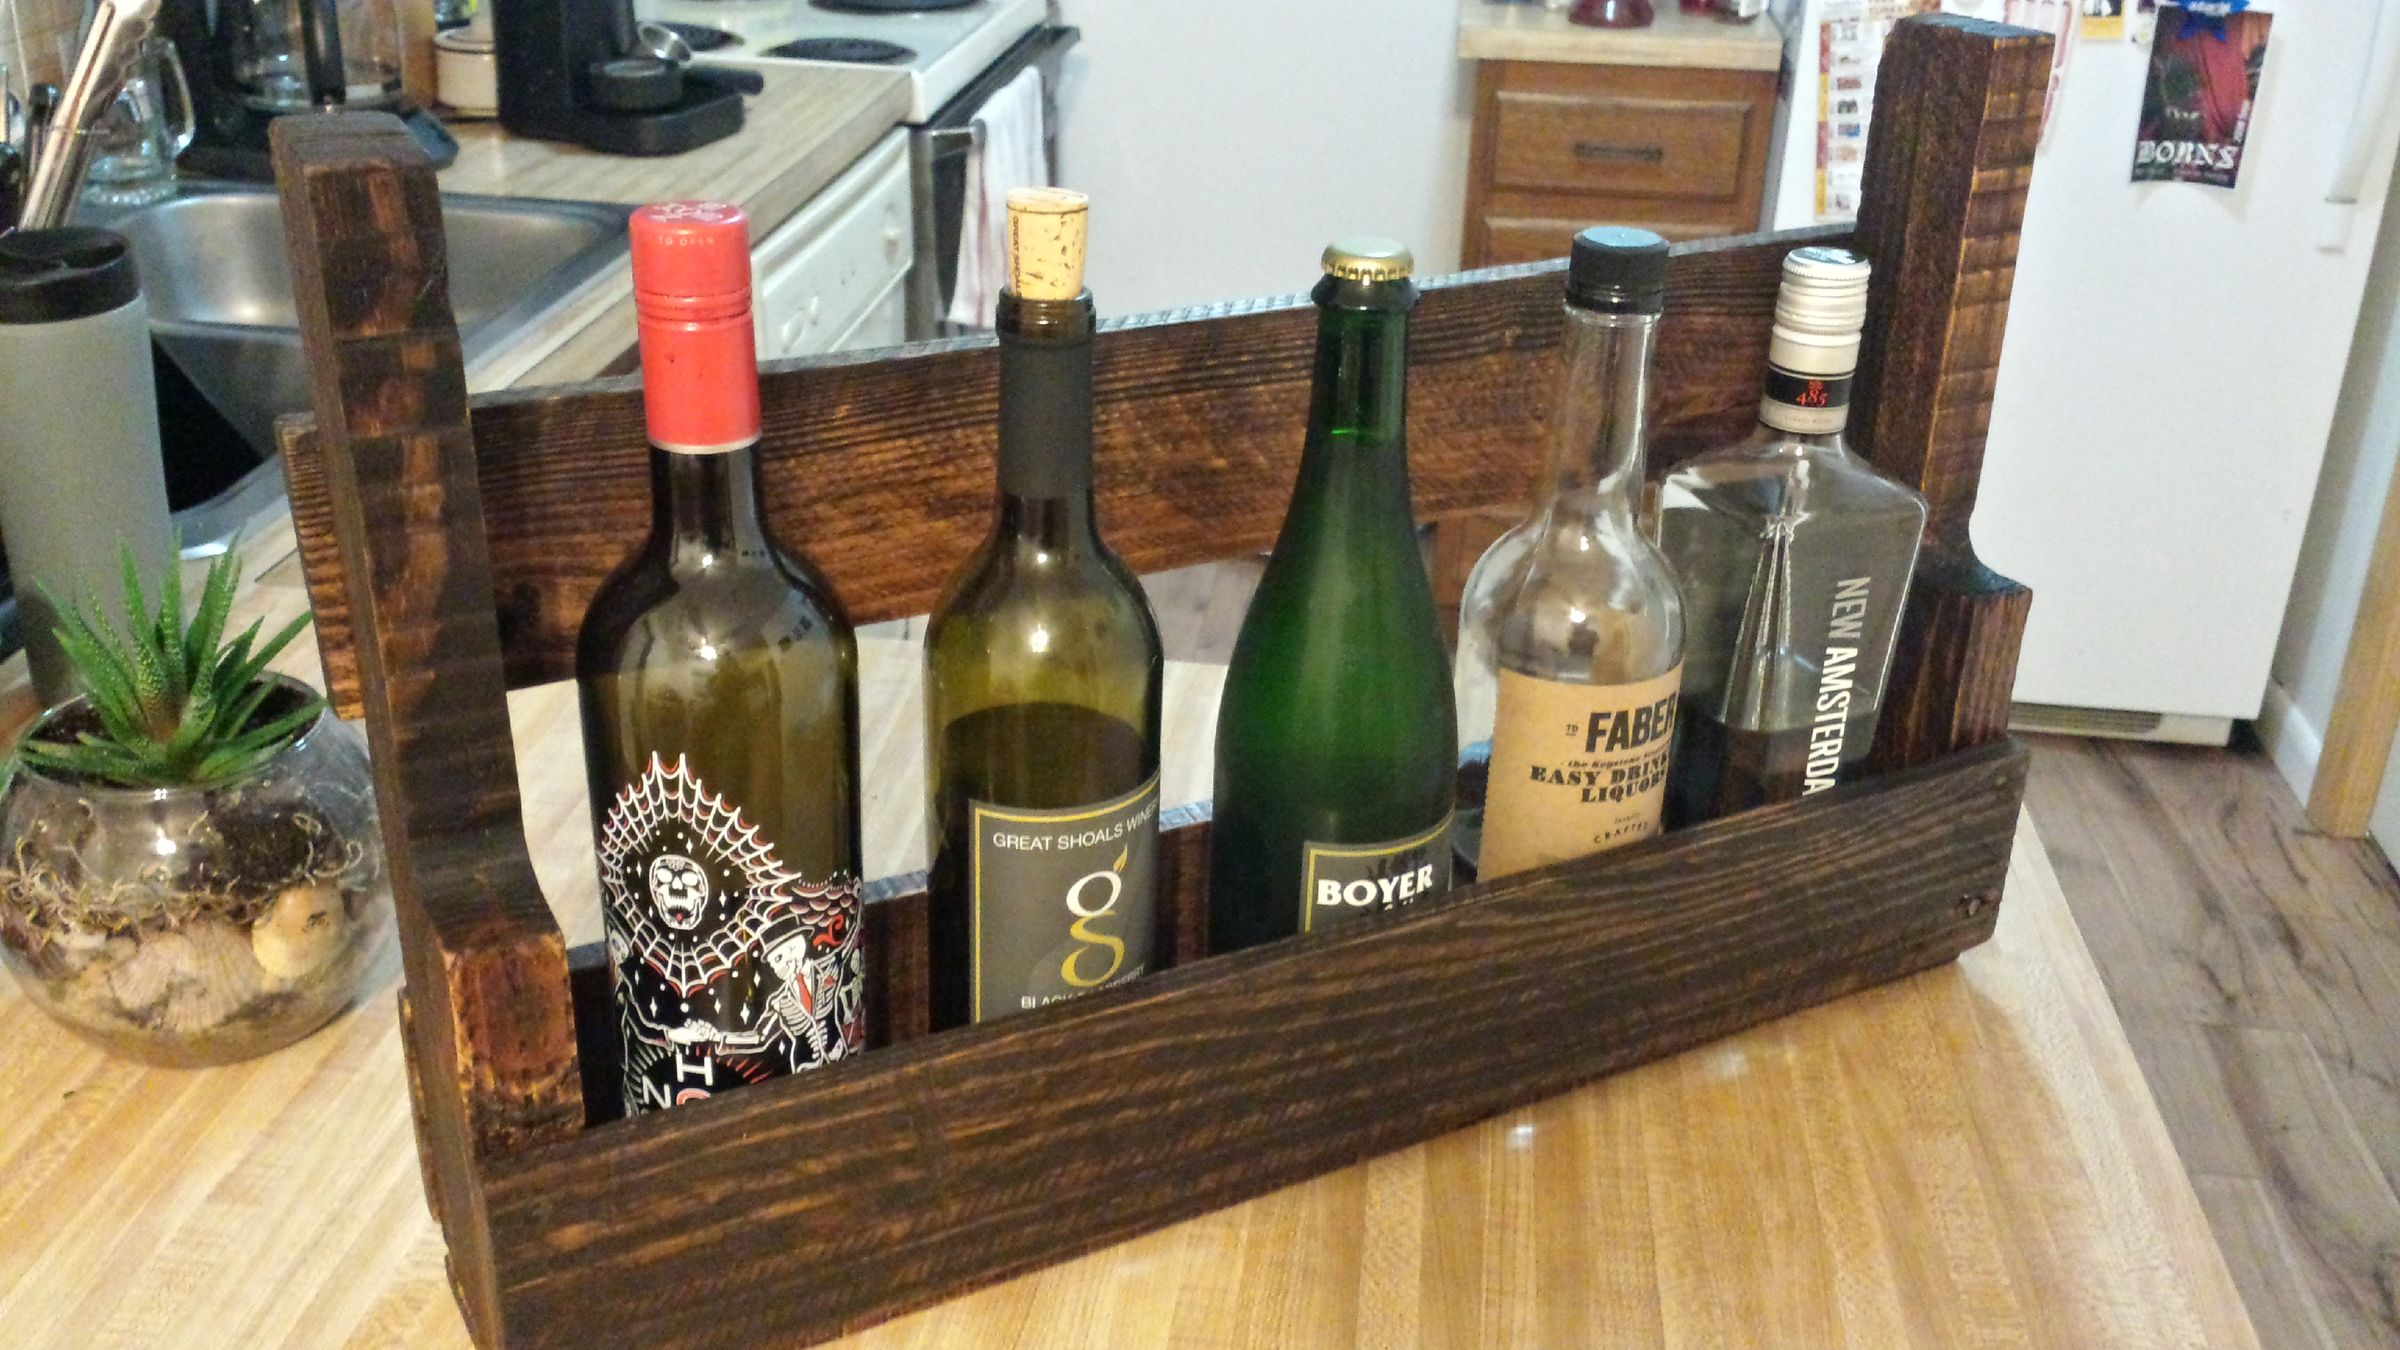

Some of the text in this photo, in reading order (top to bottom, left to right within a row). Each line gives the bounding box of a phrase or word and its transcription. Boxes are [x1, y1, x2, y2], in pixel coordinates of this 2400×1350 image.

[1796, 390, 1829, 408] 485
[1828, 577, 1871, 639] NEW
[1530, 765, 1601, 786] EASY
[993, 831, 1053, 851] GREAT
[1057, 823, 1123, 850] SHOALS
[1317, 864, 1433, 907] BOYER
